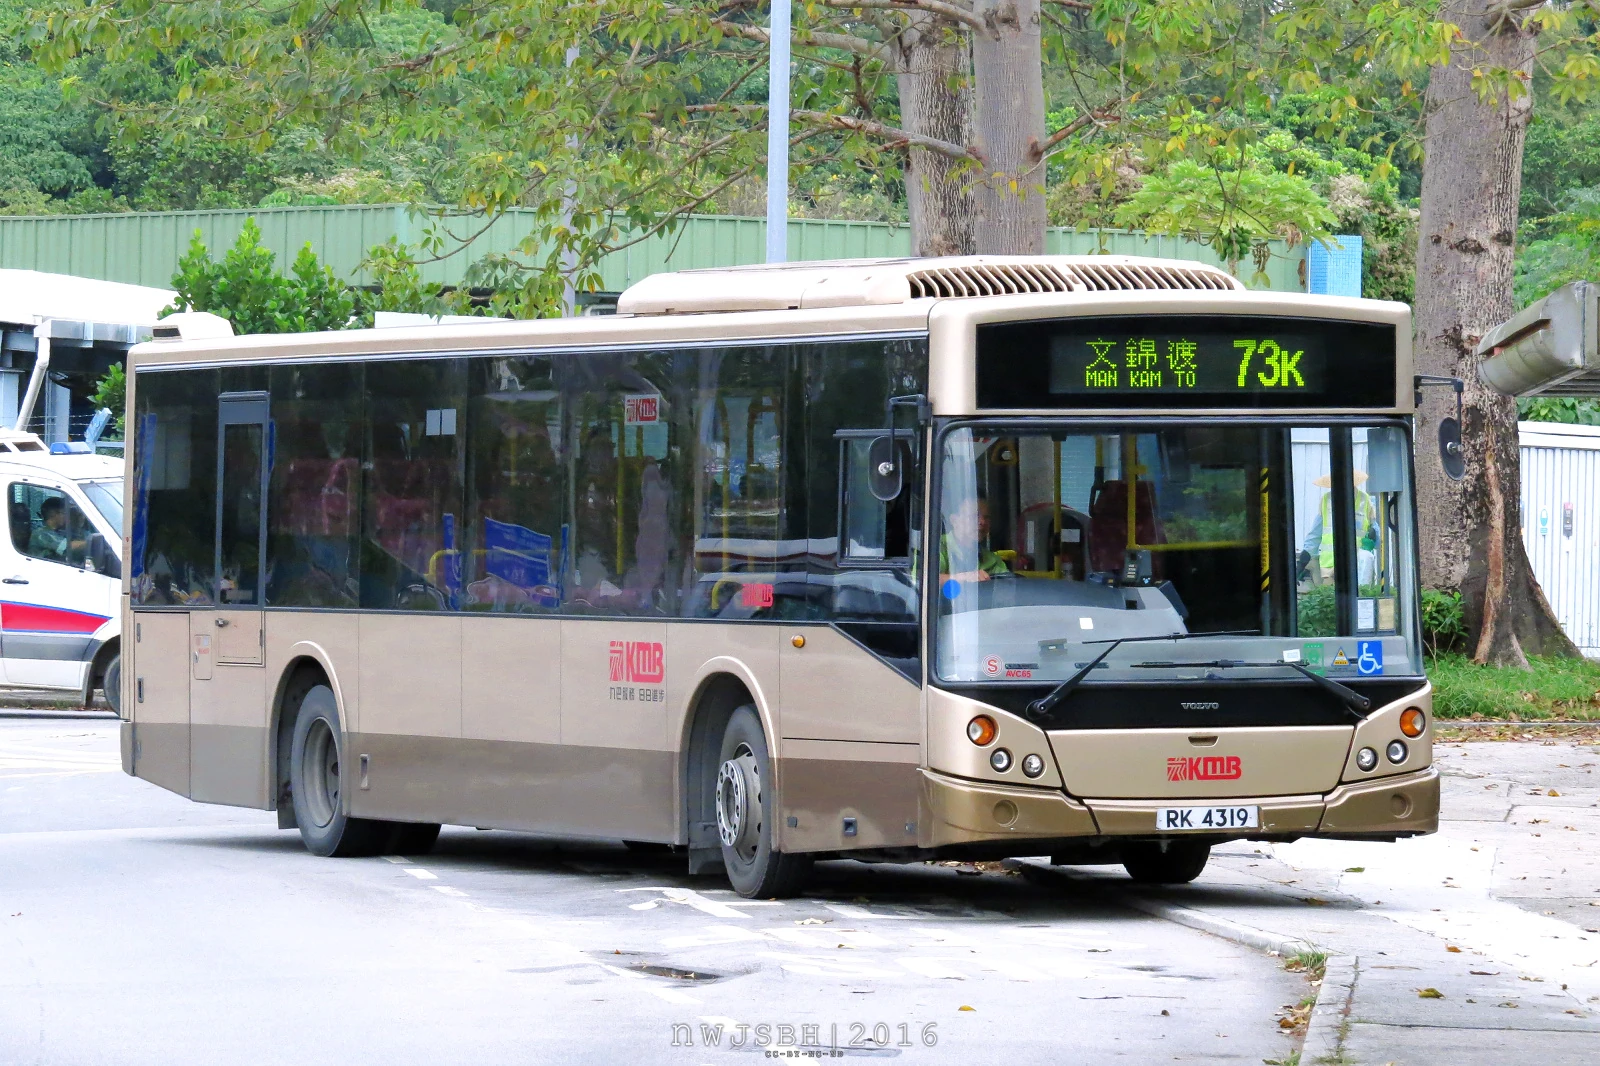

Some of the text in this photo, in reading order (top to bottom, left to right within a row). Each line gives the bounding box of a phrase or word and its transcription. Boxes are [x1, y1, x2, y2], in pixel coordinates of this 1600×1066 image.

[1085, 337, 1198, 370] 文錦渡
[1232, 339, 1305, 387] 73K
[1085, 370, 1196, 387] MAN KAM TO
[635, 398, 657, 422] KMB
[625, 641, 664, 683] KMB
[987, 658, 998, 673] S
[1005, 669, 1032, 678] AVC65
[1181, 702, 1220, 710] VOLVO
[1188, 756, 1242, 780] KMB
[1166, 808, 1249, 828] RK 4319
